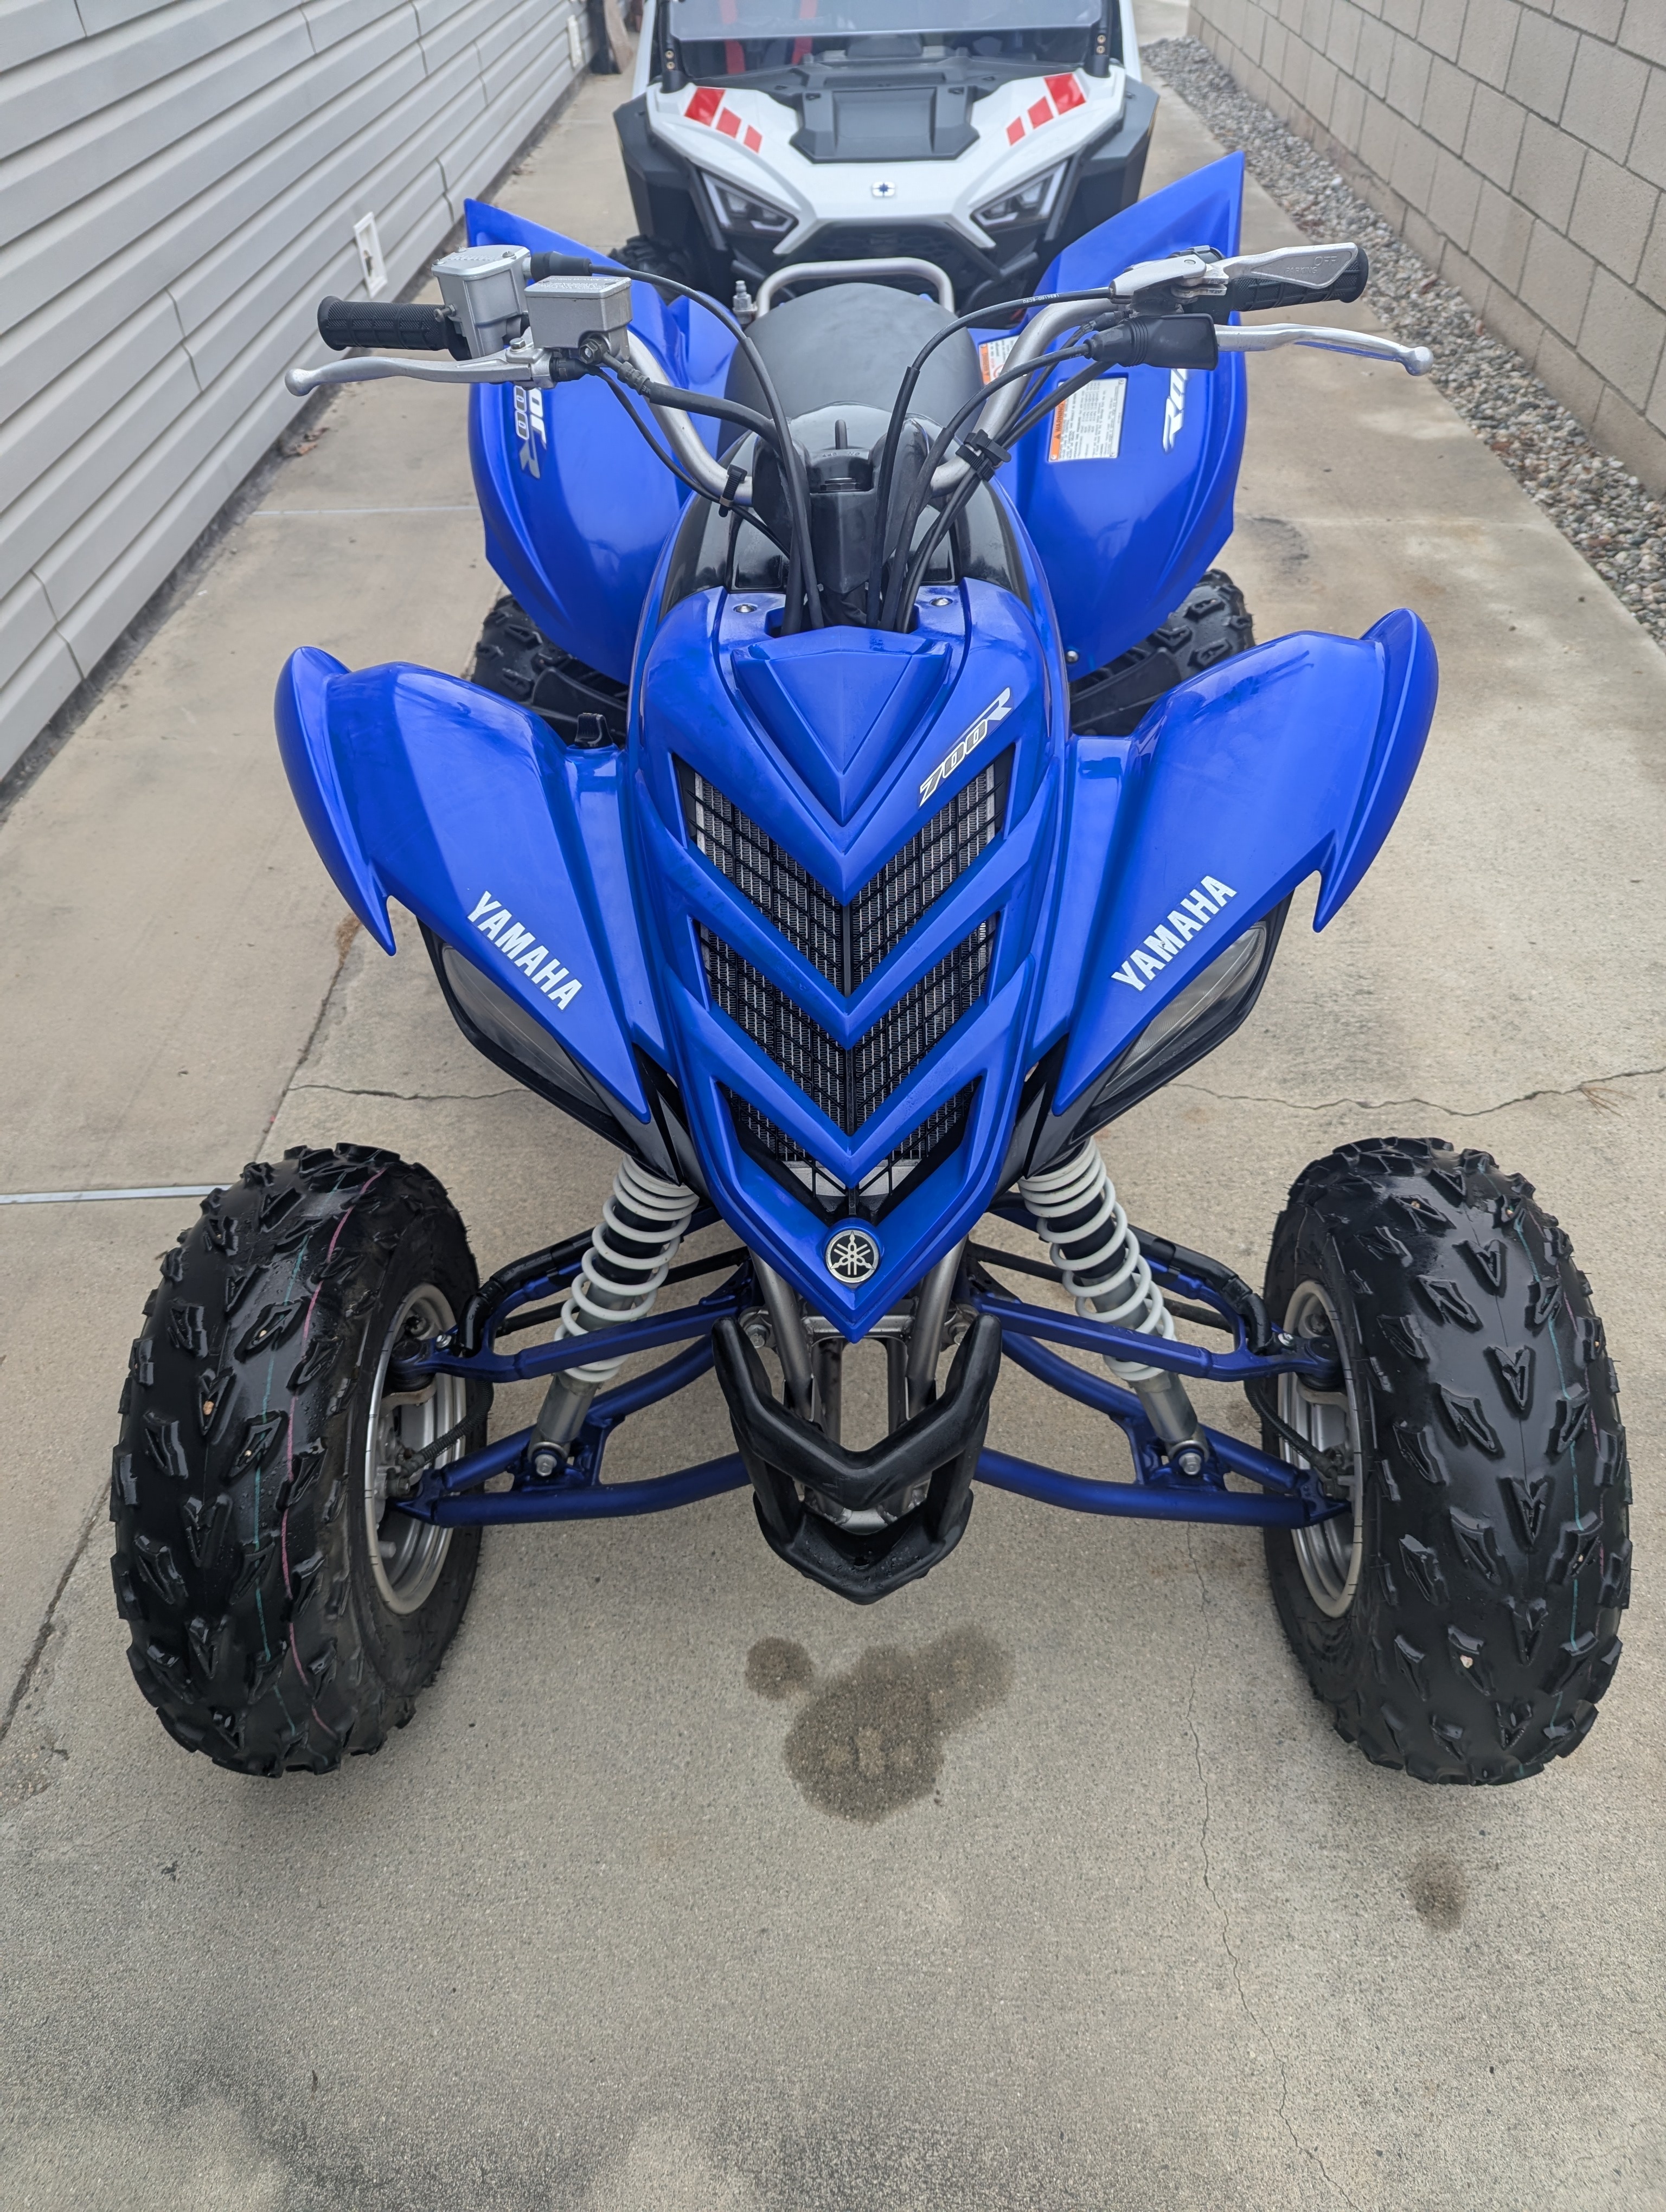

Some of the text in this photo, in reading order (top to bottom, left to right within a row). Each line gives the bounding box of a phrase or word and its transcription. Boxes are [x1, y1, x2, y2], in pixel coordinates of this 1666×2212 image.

[1315, 256, 1337, 266] OFF
[513, 385, 541, 479] 00R
[1055, 403, 1064, 433] WARNING
[919, 687, 1011, 808] 700R
[467, 890, 583, 1011] YAMAHA
[1111, 875, 1238, 992] YAMAHA
